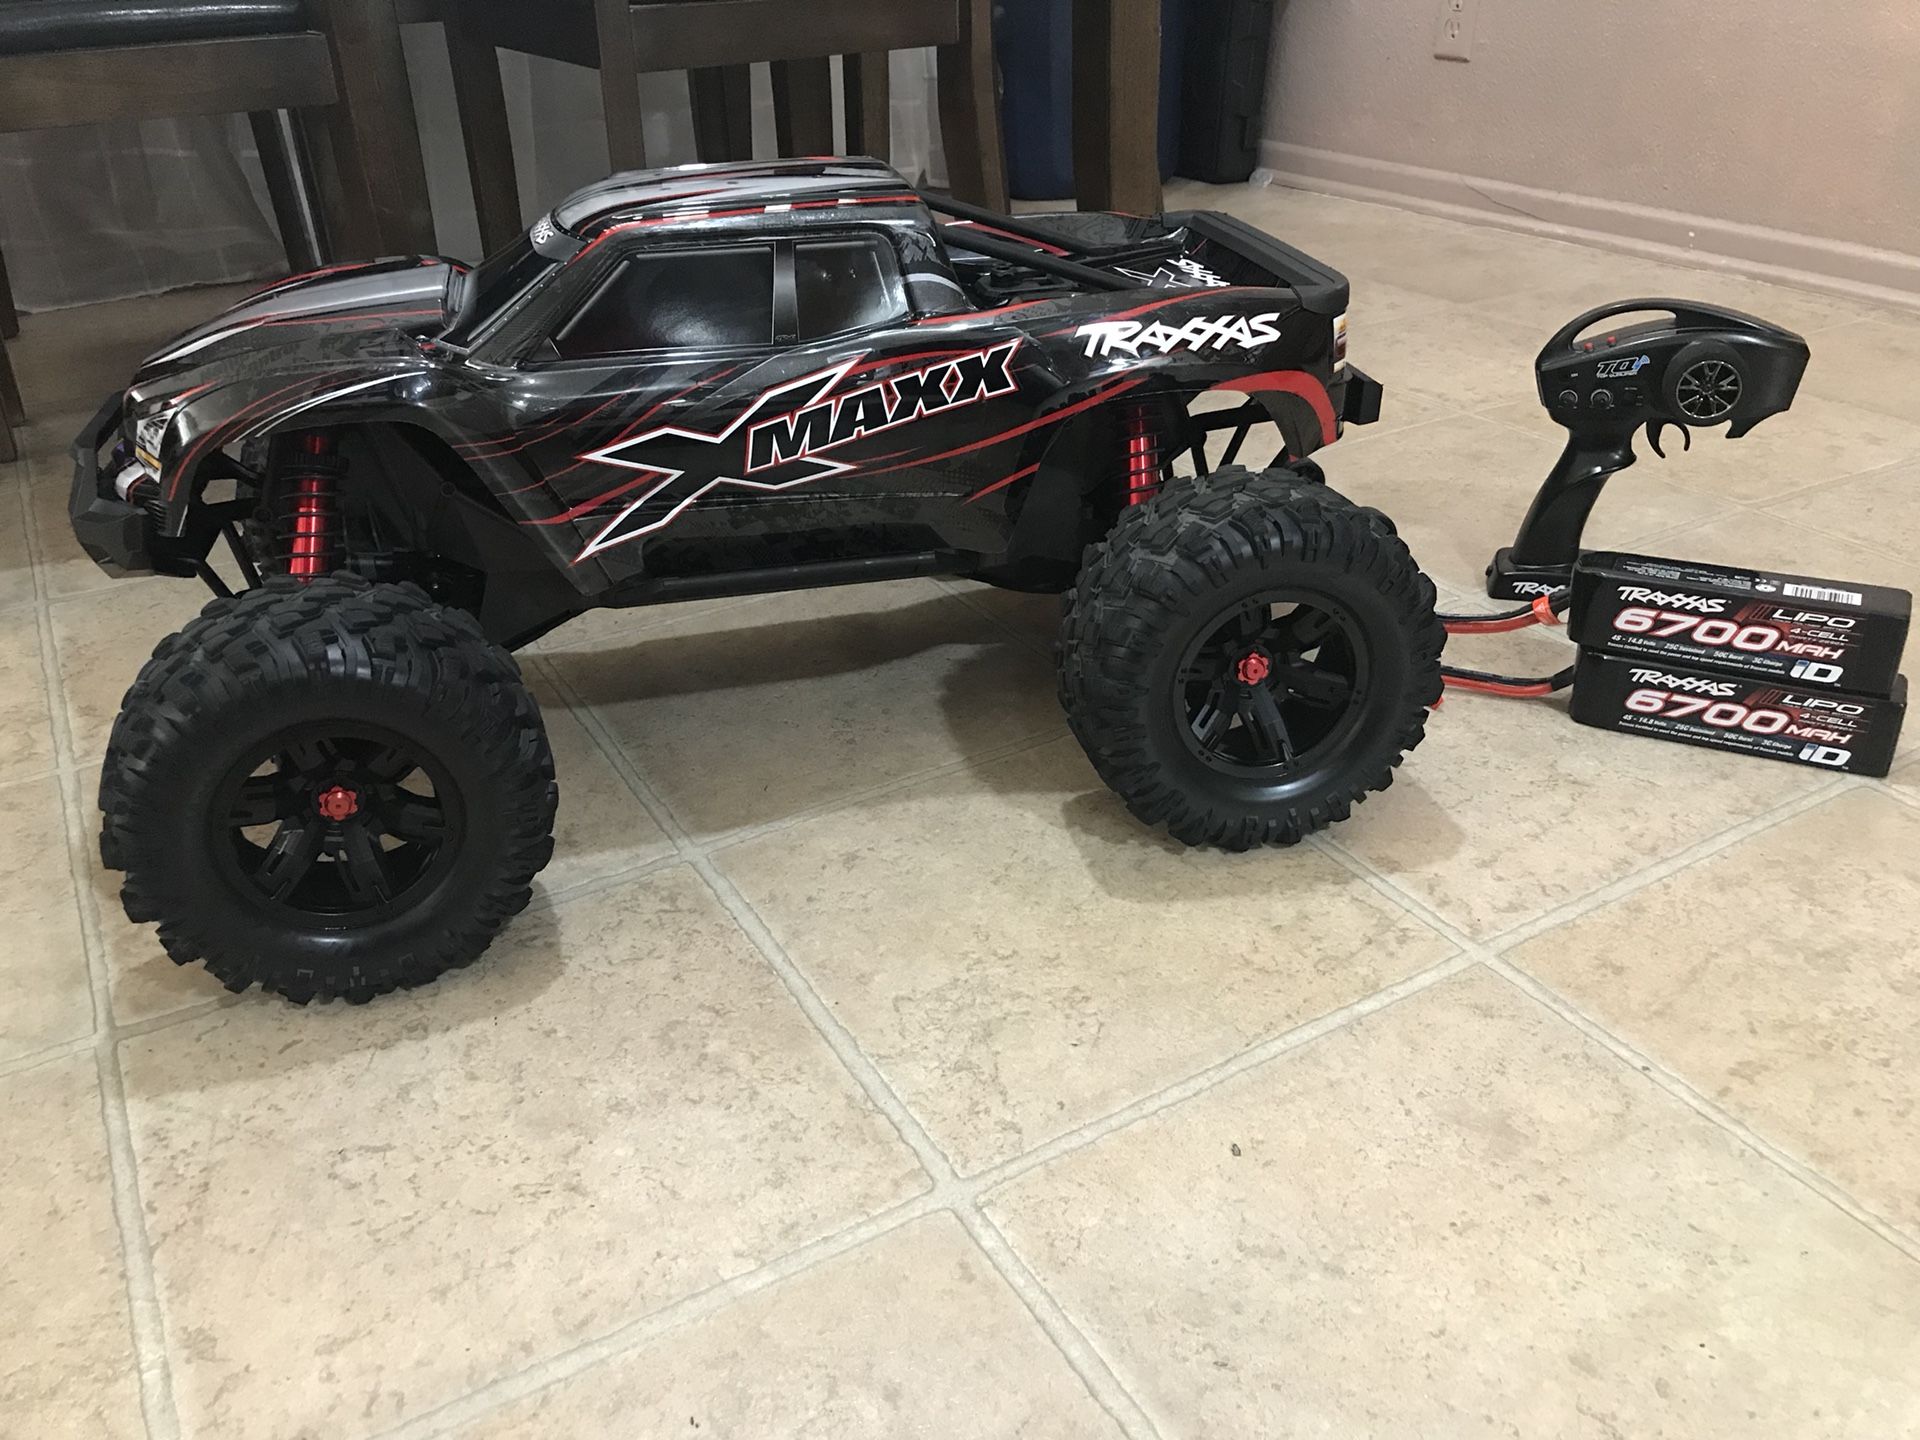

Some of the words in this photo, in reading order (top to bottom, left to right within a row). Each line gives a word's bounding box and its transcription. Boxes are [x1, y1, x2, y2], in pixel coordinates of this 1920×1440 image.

[1074, 312, 1282, 358] TRAXXAS
[1511, 581, 1566, 596] TRAX
[1617, 586, 1727, 613] TRAXXAS
[1614, 607, 1780, 651] 6700
[1772, 609, 1856, 628] LIPO
[1790, 628, 1849, 641] 4-CELL
[1629, 668, 1737, 696] TRAXXAS
[1625, 688, 1791, 734] 6700
[1782, 694, 1864, 715] LIPO
[1800, 712, 1857, 727] 4-CELL
